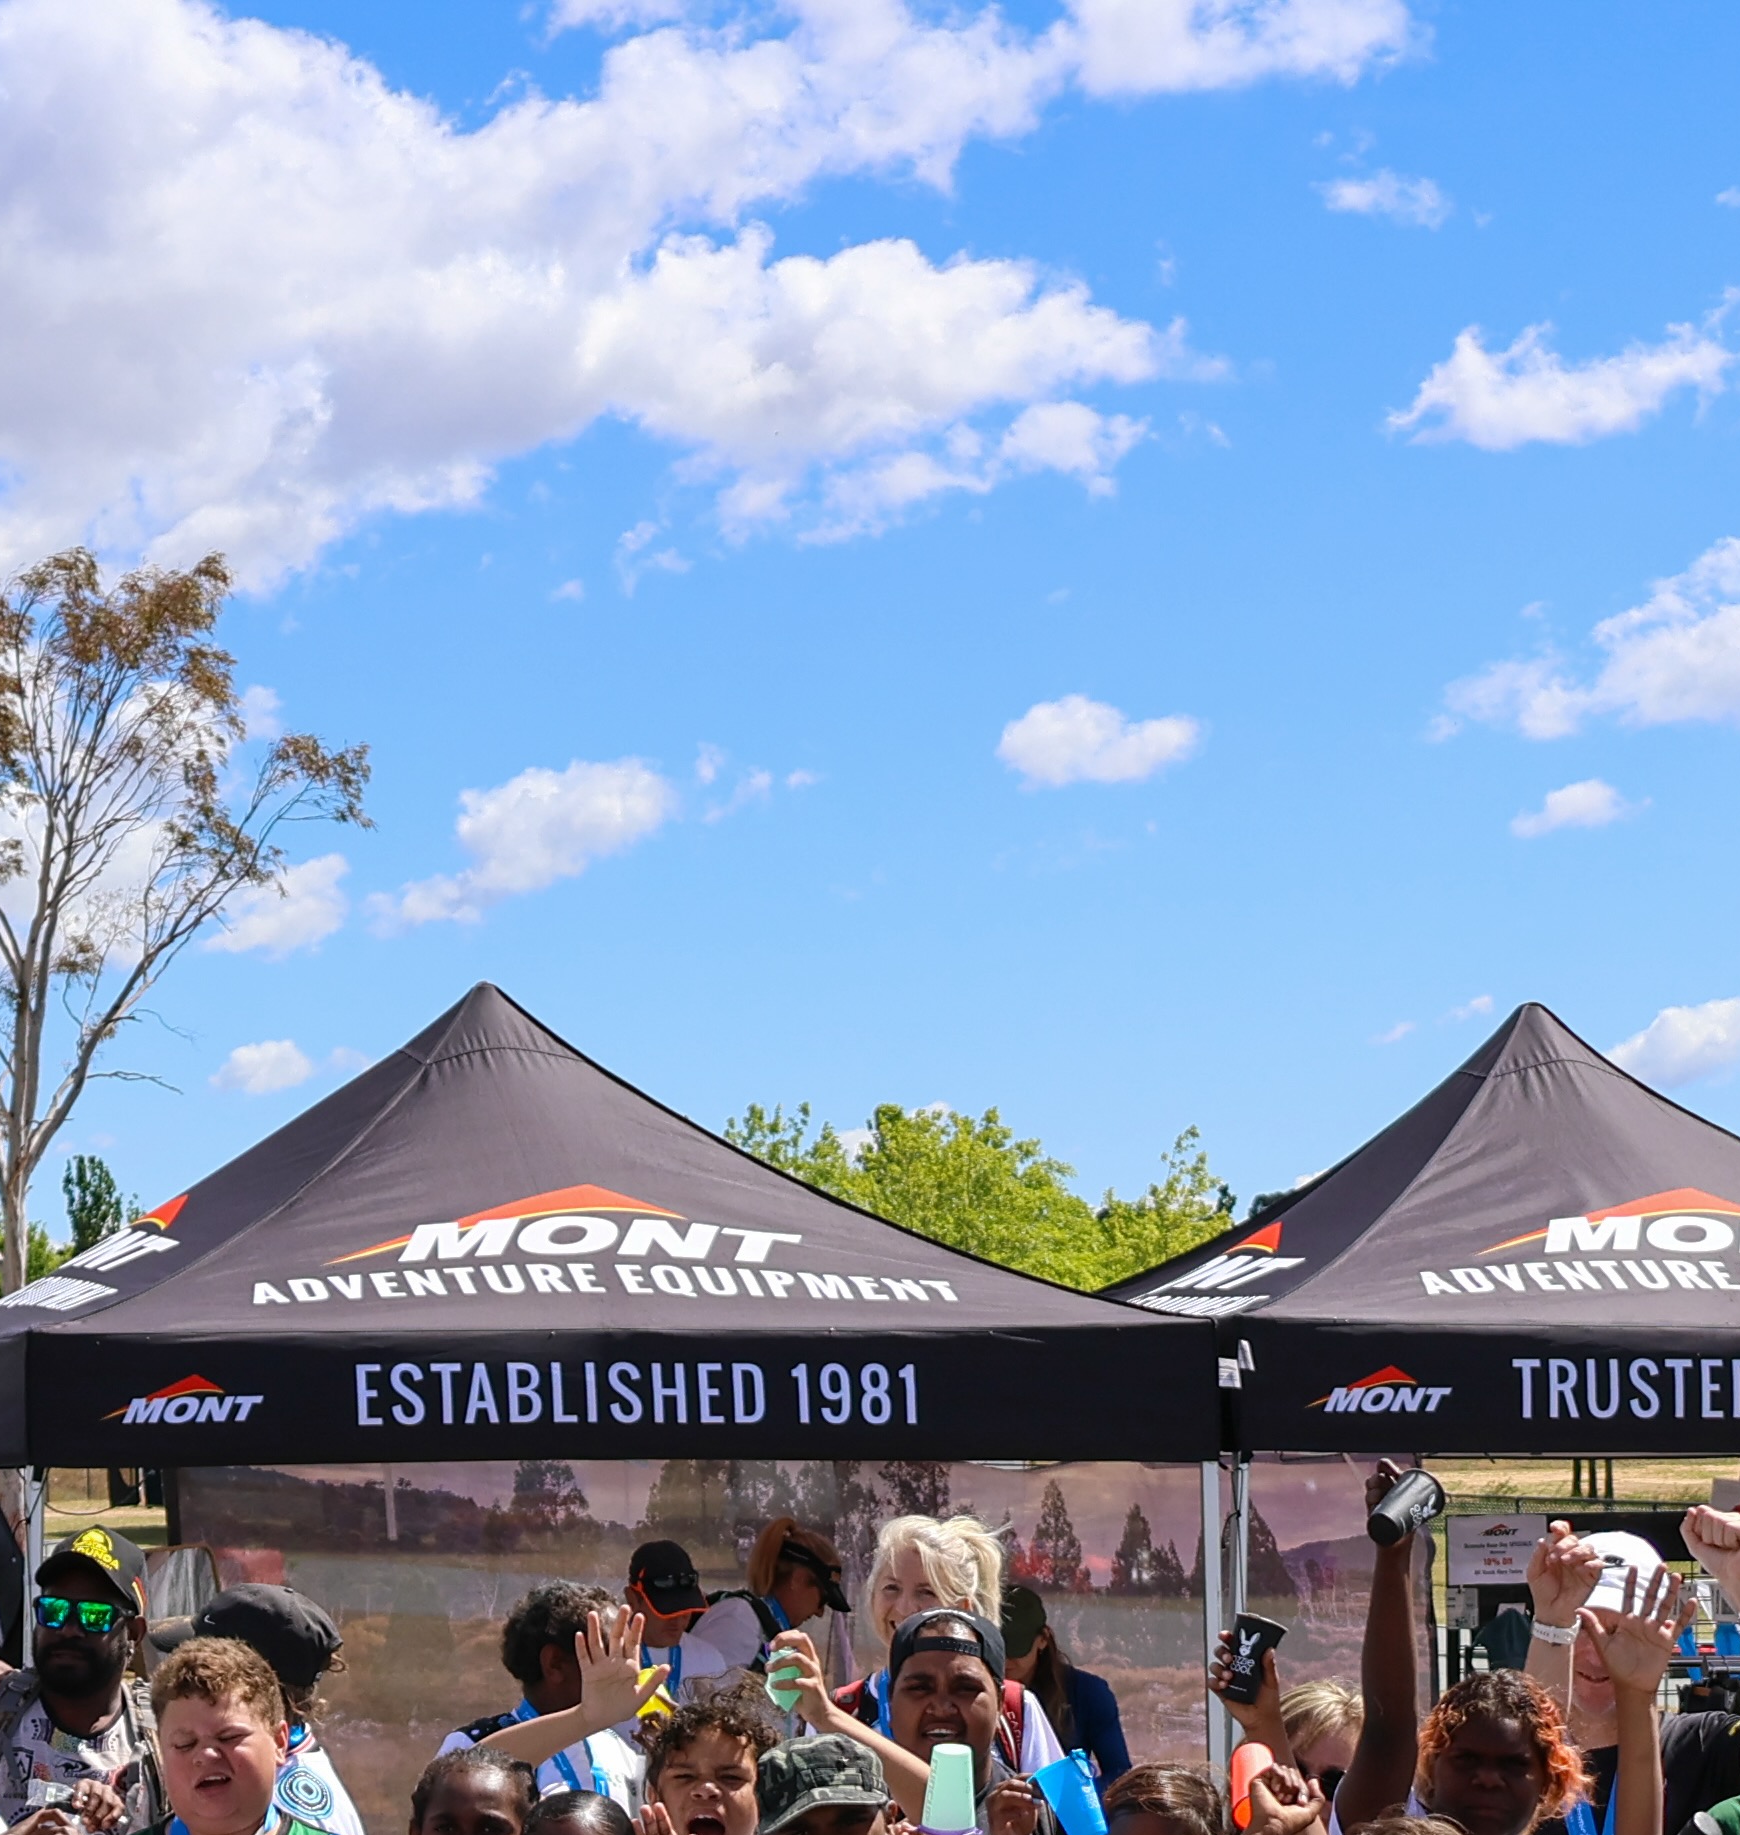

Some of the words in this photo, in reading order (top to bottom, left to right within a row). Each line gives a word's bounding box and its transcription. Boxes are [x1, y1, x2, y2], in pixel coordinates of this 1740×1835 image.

[399, 1216, 803, 1263] MONT
[252, 1263, 606, 1304] ADVENTURE
[627, 1264, 960, 1303] EQUIPMENT
[1419, 1257, 1739, 1296] ADVENTURE
[122, 1394, 265, 1424] MONT
[354, 1360, 767, 1426] ESTABLISHED
[790, 1361, 920, 1426] 1981
[1324, 1386, 1452, 1413] MONT
